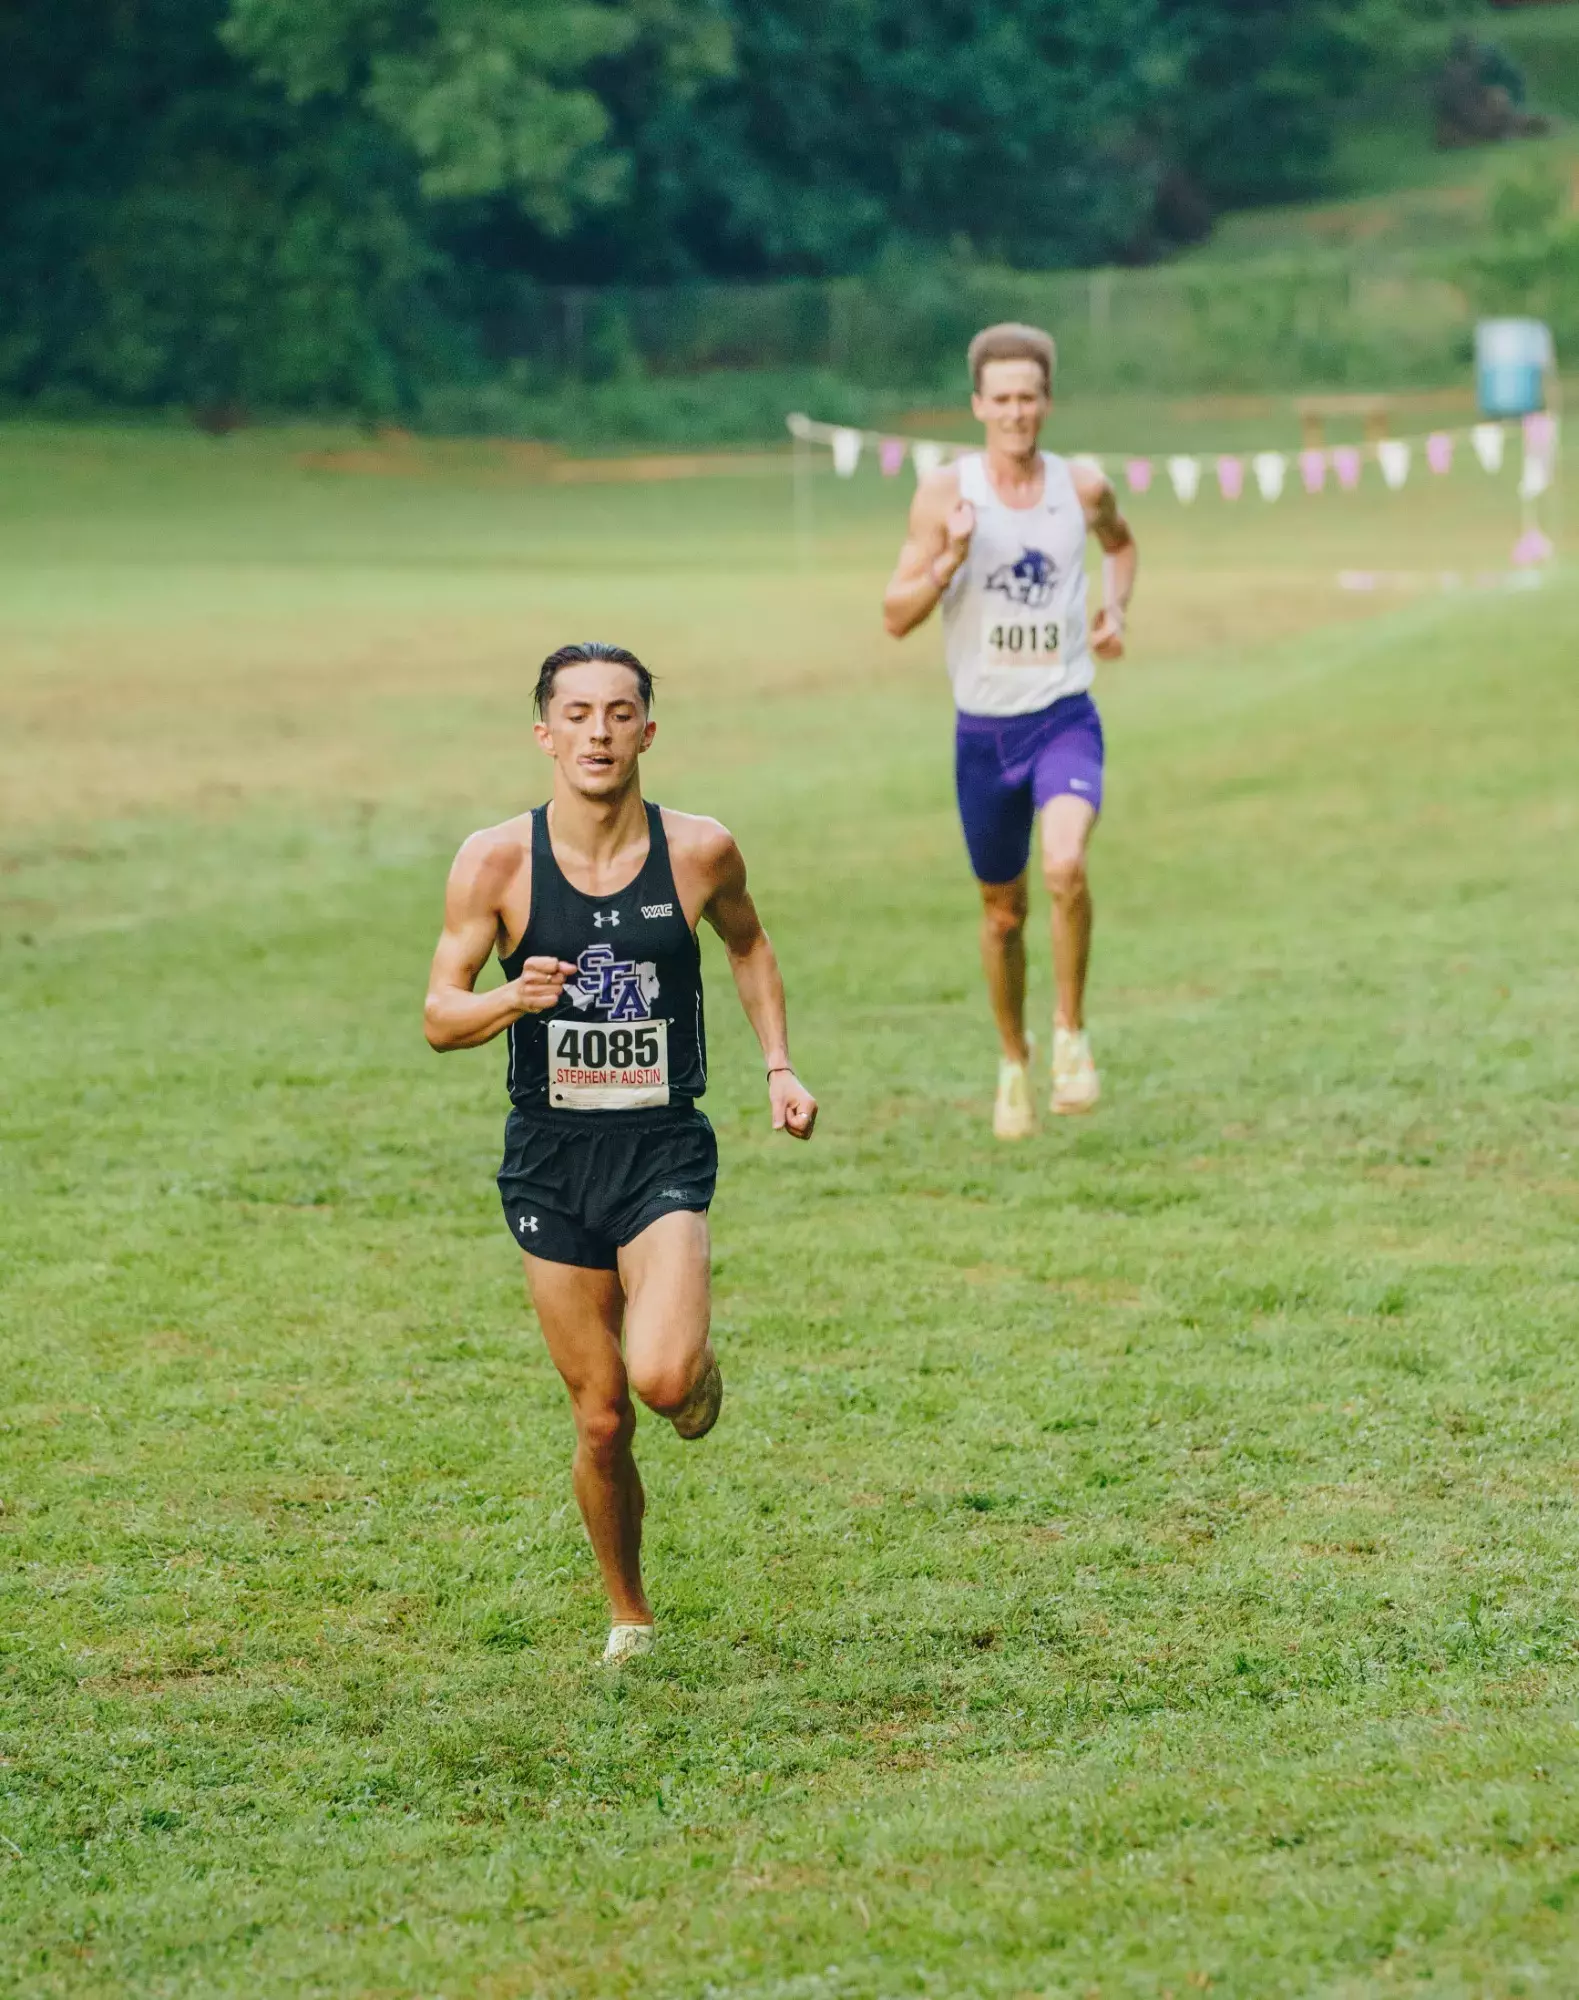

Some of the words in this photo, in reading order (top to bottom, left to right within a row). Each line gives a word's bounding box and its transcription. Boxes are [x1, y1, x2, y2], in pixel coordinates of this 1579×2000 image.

[989, 622, 1060, 653] 4013
[641, 903, 673, 918] WAC
[577, 943, 650, 1021] SFA
[556, 1028, 659, 1069] 4085
[556, 1069, 607, 1084] STEPHEN
[610, 1070, 619, 1084] F.
[621, 1068, 661, 1084] AUSTIN
